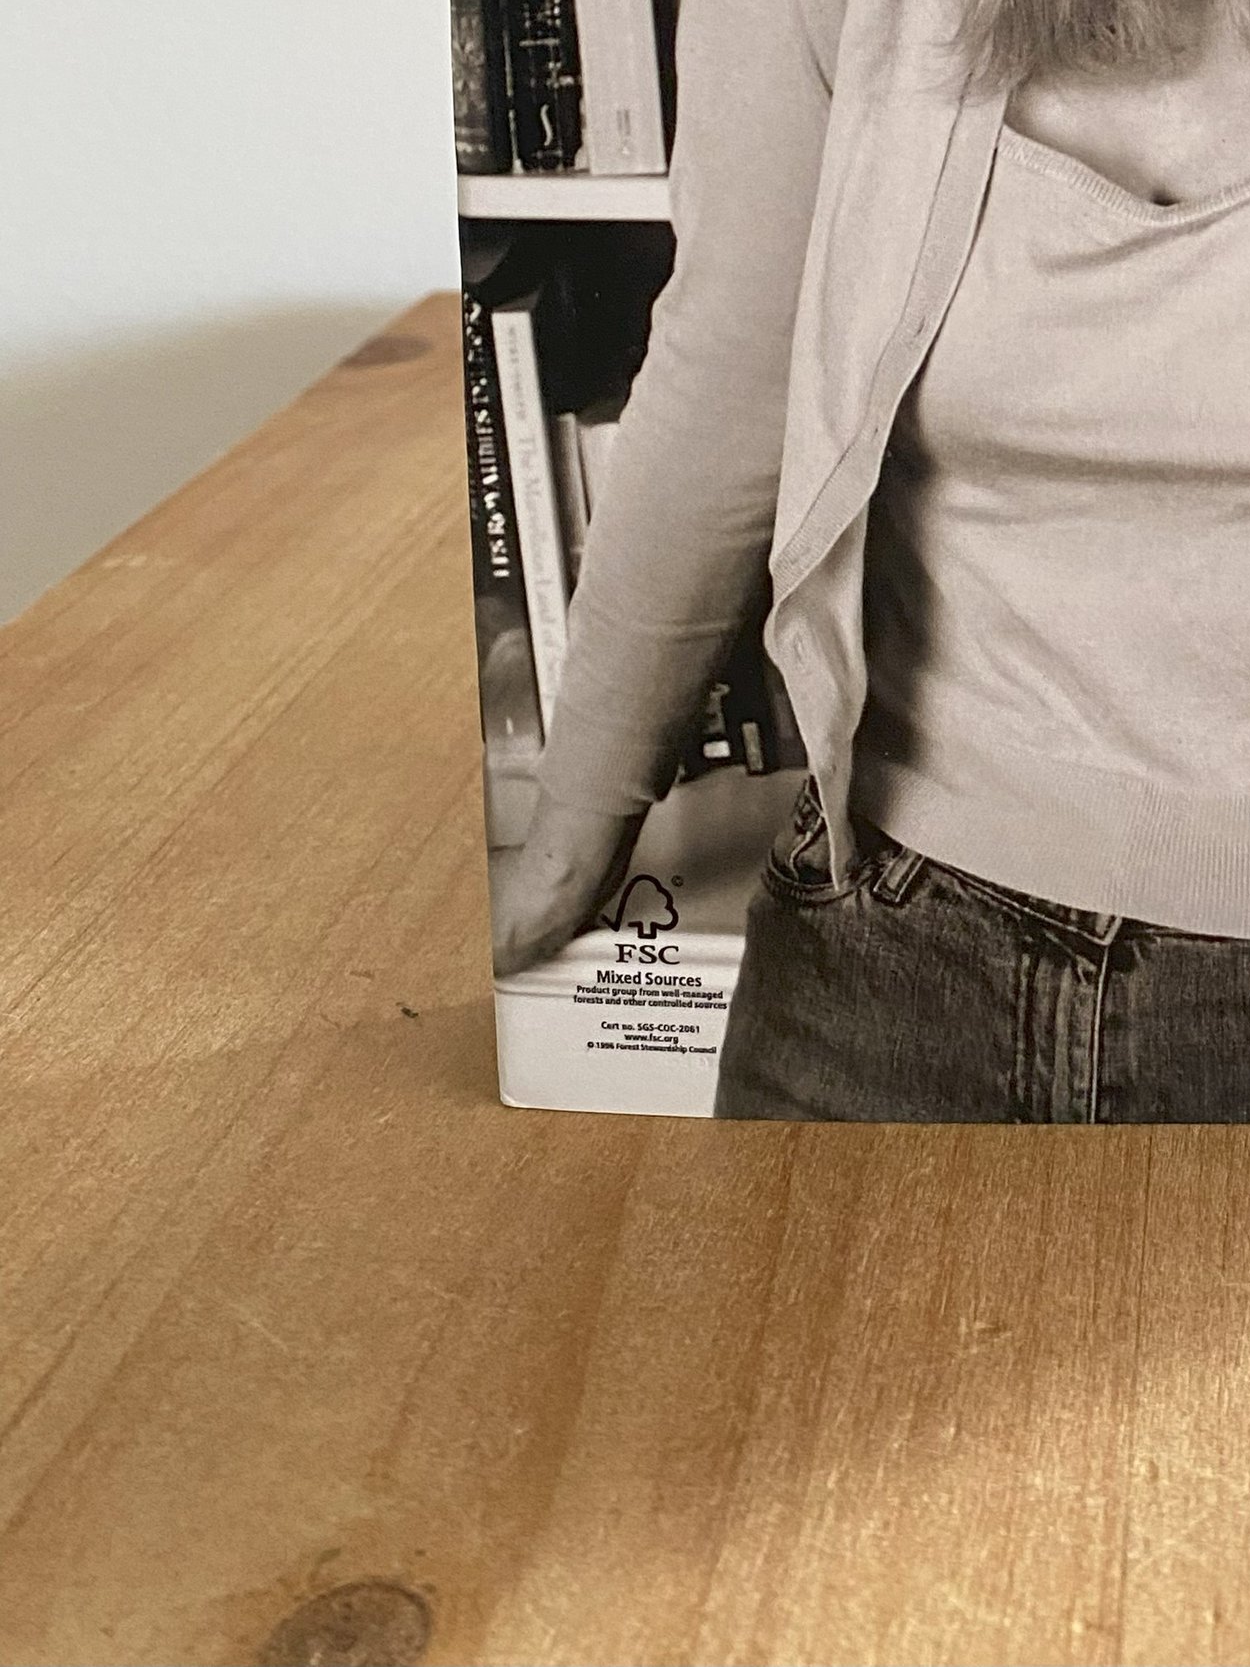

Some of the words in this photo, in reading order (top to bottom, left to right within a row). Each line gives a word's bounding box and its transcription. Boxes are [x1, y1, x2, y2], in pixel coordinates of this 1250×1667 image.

[614, 943, 681, 965] FSC
[596, 969, 642, 985] Mixed
[644, 972, 703, 987] Sources
[576, 984, 611, 995] Product
[611, 987, 638, 999] group
[638, 987, 660, 997] from
[660, 989, 724, 1001] well-managed
[573, 994, 604, 1005] forests
[605, 997, 621, 1005] and
[622, 997, 647, 1007] other
[648, 999, 693, 1009] controlled
[694, 1001, 728, 1010] sources
[621, 1023, 636, 1031] no.
[615, 1042, 640, 1051] Forest
[623, 1033, 679, 1045] www.fsc.org
